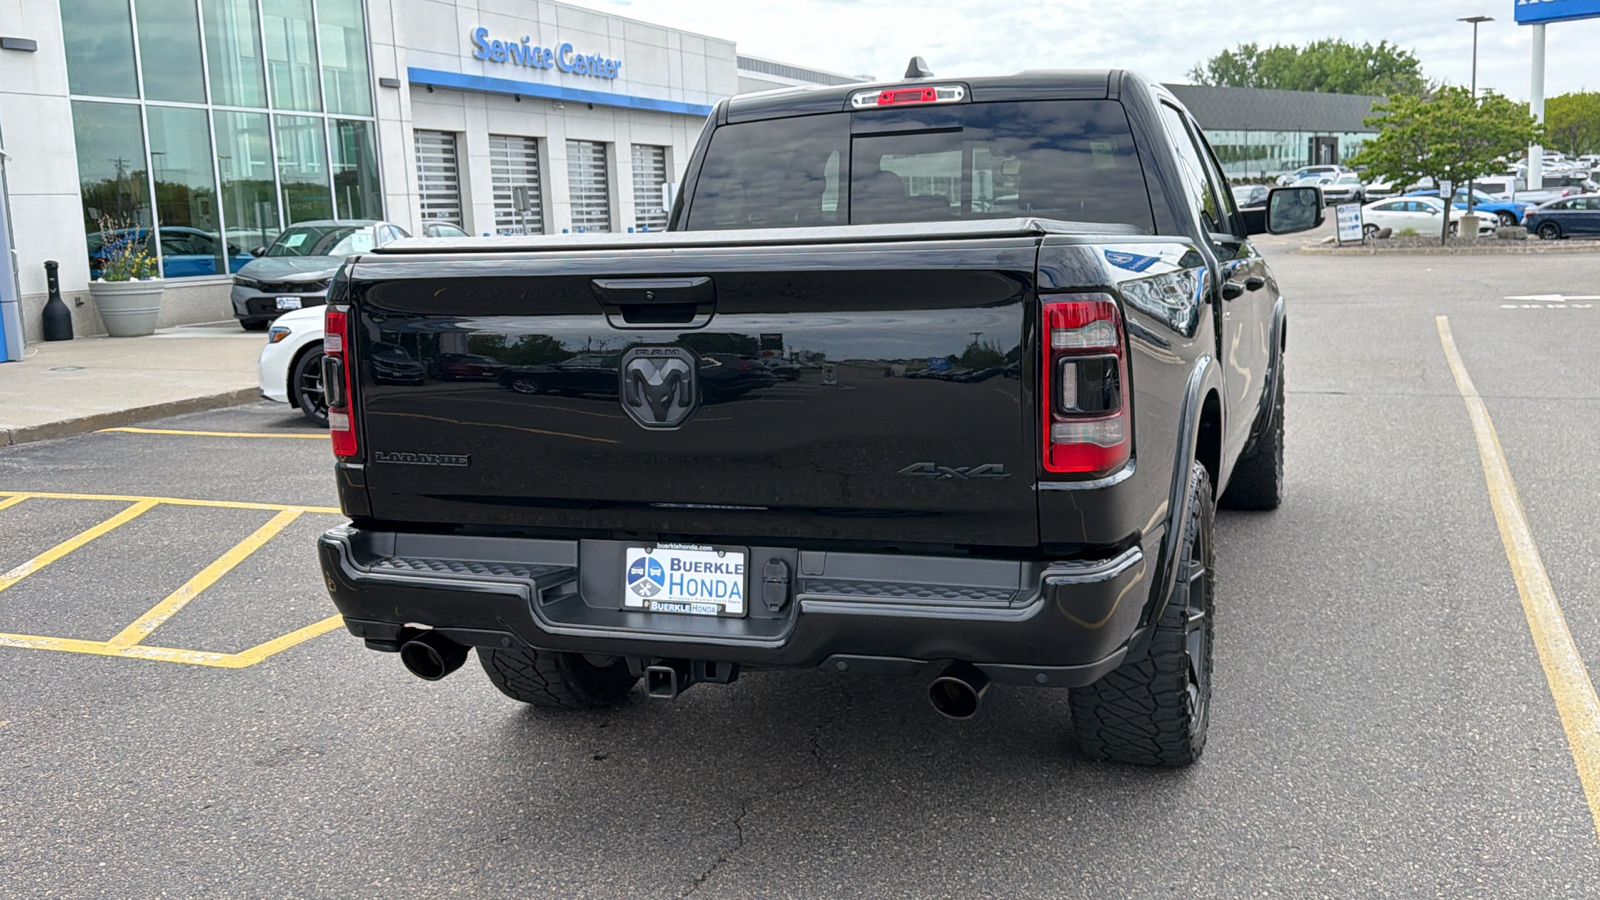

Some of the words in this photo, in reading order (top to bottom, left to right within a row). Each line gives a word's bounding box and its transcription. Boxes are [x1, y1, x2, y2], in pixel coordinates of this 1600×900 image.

[471, 26, 554, 69] Service
[555, 42, 622, 79] Center
[635, 348, 680, 356] RAM
[656, 542, 713, 551] buerklehonda.com
[670, 557, 743, 575] BUERKLE
[669, 572, 741, 599] HONDA
[651, 601, 691, 612] BUERKLE
[692, 603, 716, 613] HONDA
